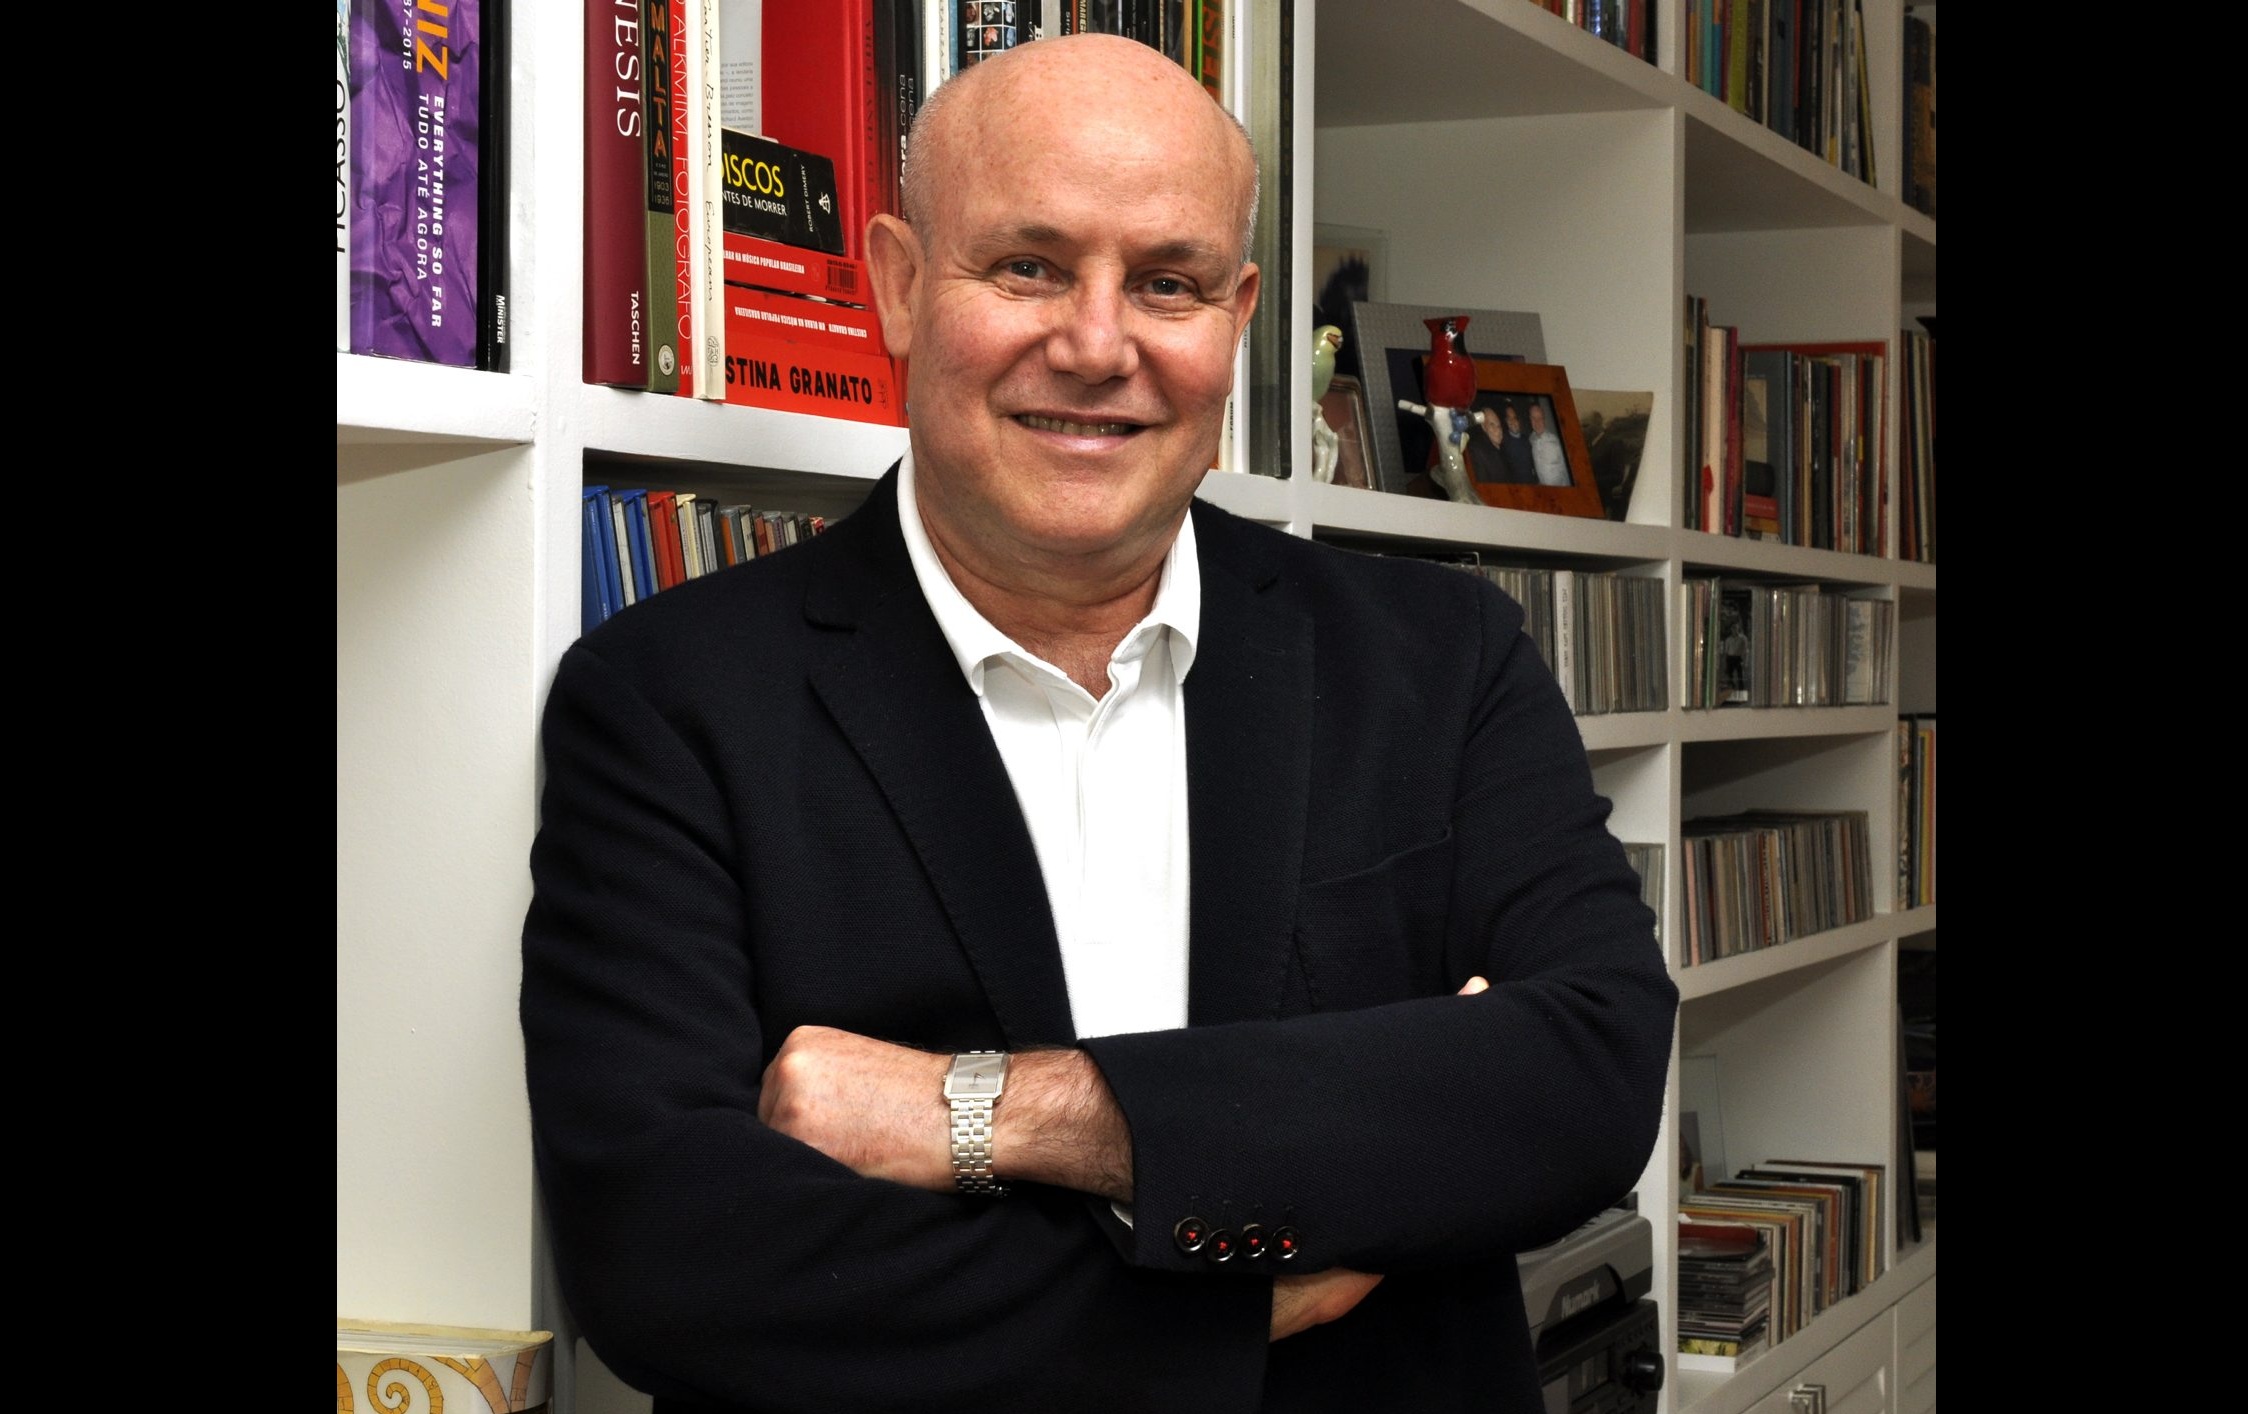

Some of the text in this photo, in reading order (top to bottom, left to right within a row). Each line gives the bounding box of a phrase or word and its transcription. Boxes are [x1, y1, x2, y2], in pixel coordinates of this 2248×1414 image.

[650, 2, 667, 158] MALTA
[672, 14, 688, 141] ALKMIM,
[417, 93, 430, 280] TUDO ATÉ AGORA
[721, 152, 785, 198] ISCOS
[742, 194, 753, 208] DE
[754, 199, 788, 216] MORRER
[801, 164, 814, 233] ROBERT DIMERY
[431, 95, 445, 327] EVERYTHING SO FAR
[759, 257, 780, 269] POPULAR
[780, 260, 805, 274] BRASILEIRA
[495, 294, 506, 344] MINISTER
[630, 291, 640, 365] TASCHEN
[789, 366, 873, 405] GRANATO
